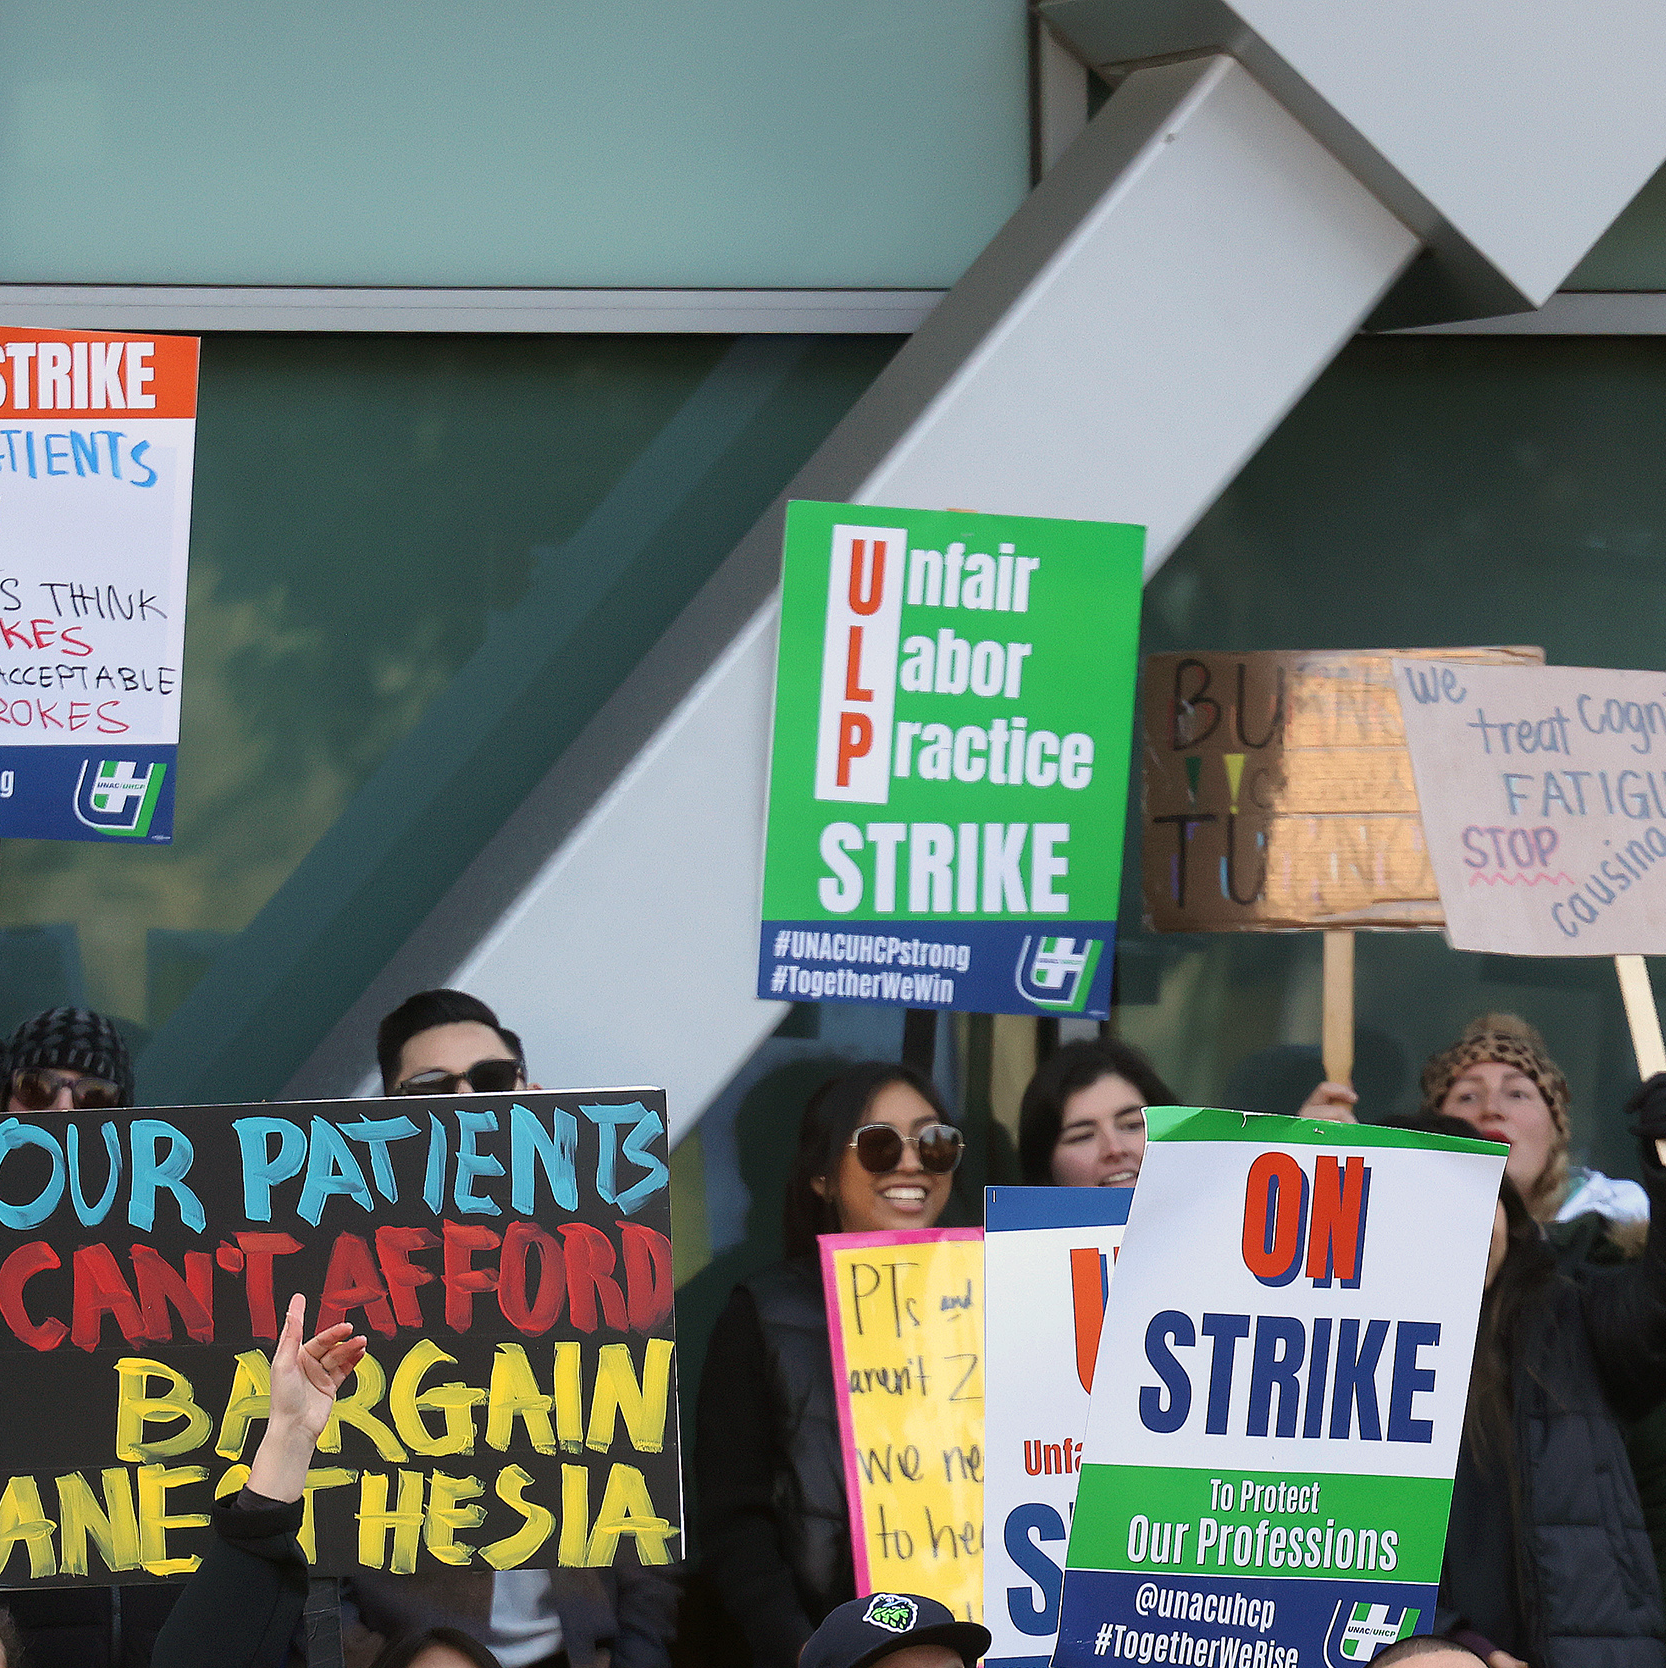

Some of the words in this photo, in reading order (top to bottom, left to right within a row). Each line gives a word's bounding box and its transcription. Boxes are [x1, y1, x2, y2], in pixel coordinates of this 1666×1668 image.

[41, 582, 168, 621] THINK
[1467, 706, 1571, 756] treat
[819, 822, 1069, 913] STRIKE
[1461, 825, 1561, 869] STOP
[774, 930, 970, 973] #UNACUHCPstrong
[771, 966, 954, 1003] #TogetherWeWin
[232, 1101, 670, 1227] PATIENTS
[1242, 1152, 1371, 1289] ON
[313, 1218, 675, 1342] AFFORD
[850, 1262, 920, 1337] PTs
[115, 1338, 675, 1465] BARGAIN
[1139, 1309, 1441, 1444] STRIKE
[1210, 1479, 1234, 1512] To
[1240, 1480, 1320, 1515] Protect
[877, 1504, 913, 1559] to
[1127, 1515, 1191, 1564] Our
[1195, 1518, 1399, 1571] Professions
[1135, 1582, 1275, 1631] @unacuhcp
[1348, 1625, 1395, 1638] UNAC/UHCP
